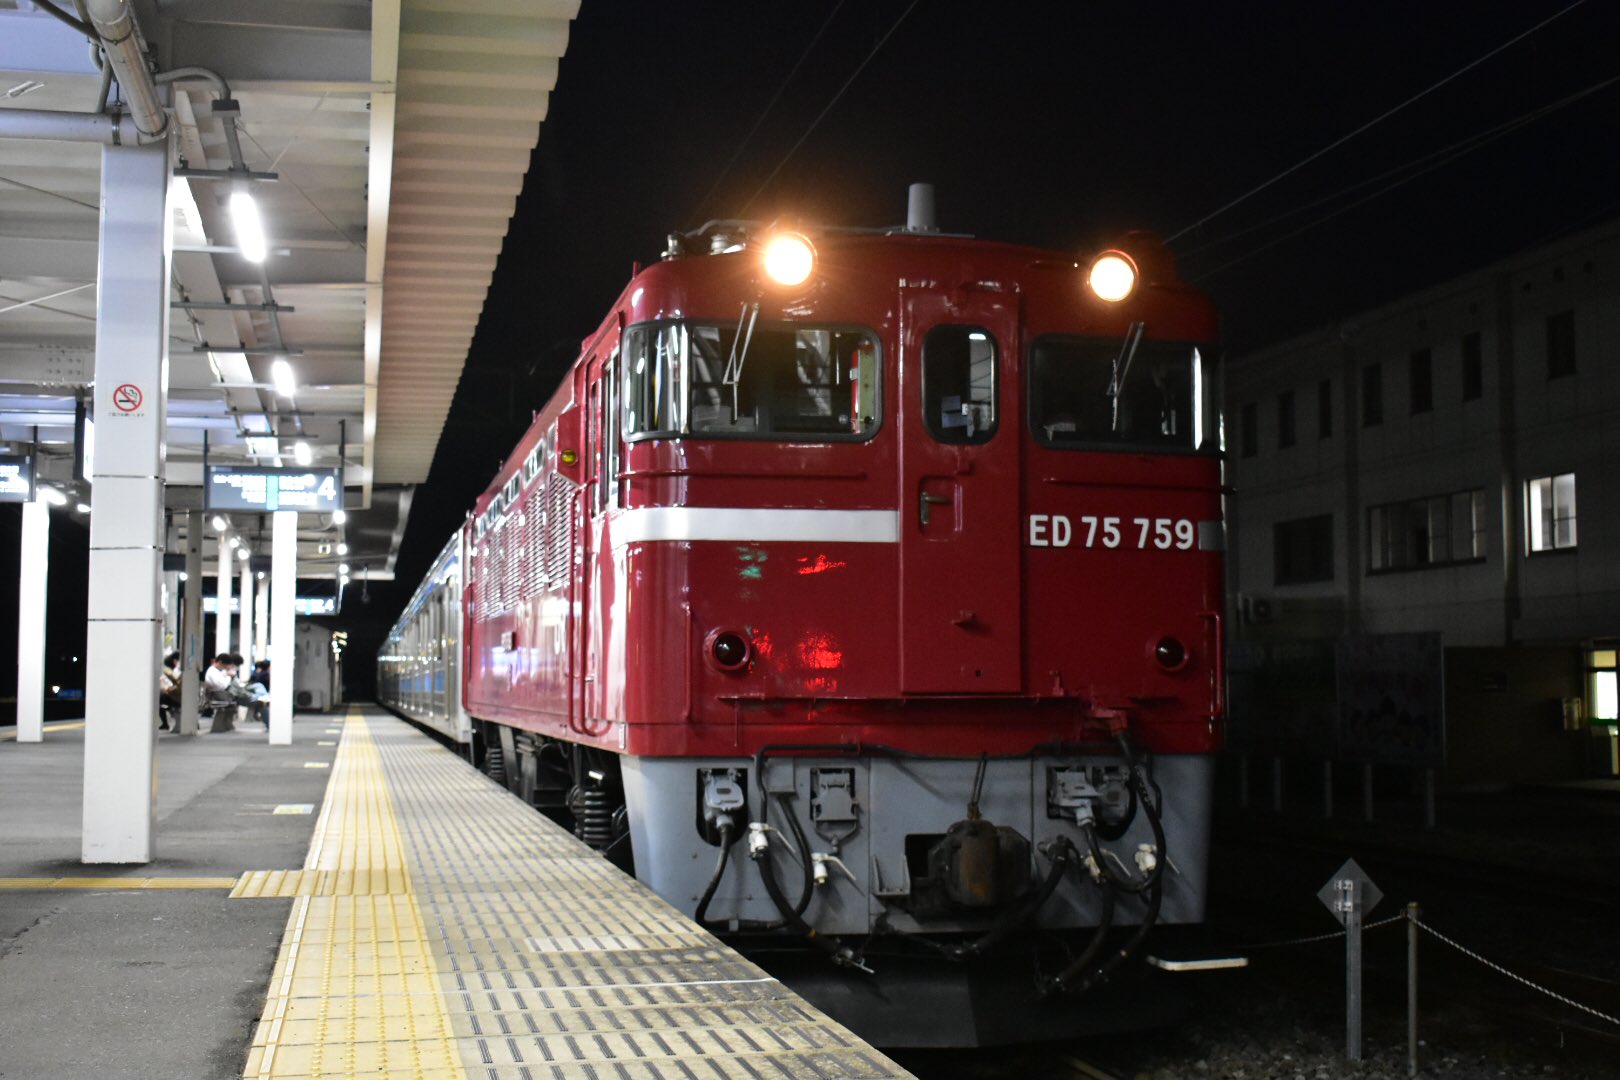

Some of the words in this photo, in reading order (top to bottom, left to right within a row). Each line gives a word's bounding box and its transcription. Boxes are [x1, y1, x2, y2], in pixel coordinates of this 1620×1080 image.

[317, 475, 337, 501] 4
[1029, 514, 1072, 547] ED
[1081, 515, 1121, 549] 75
[1133, 517, 1194, 550] 759
